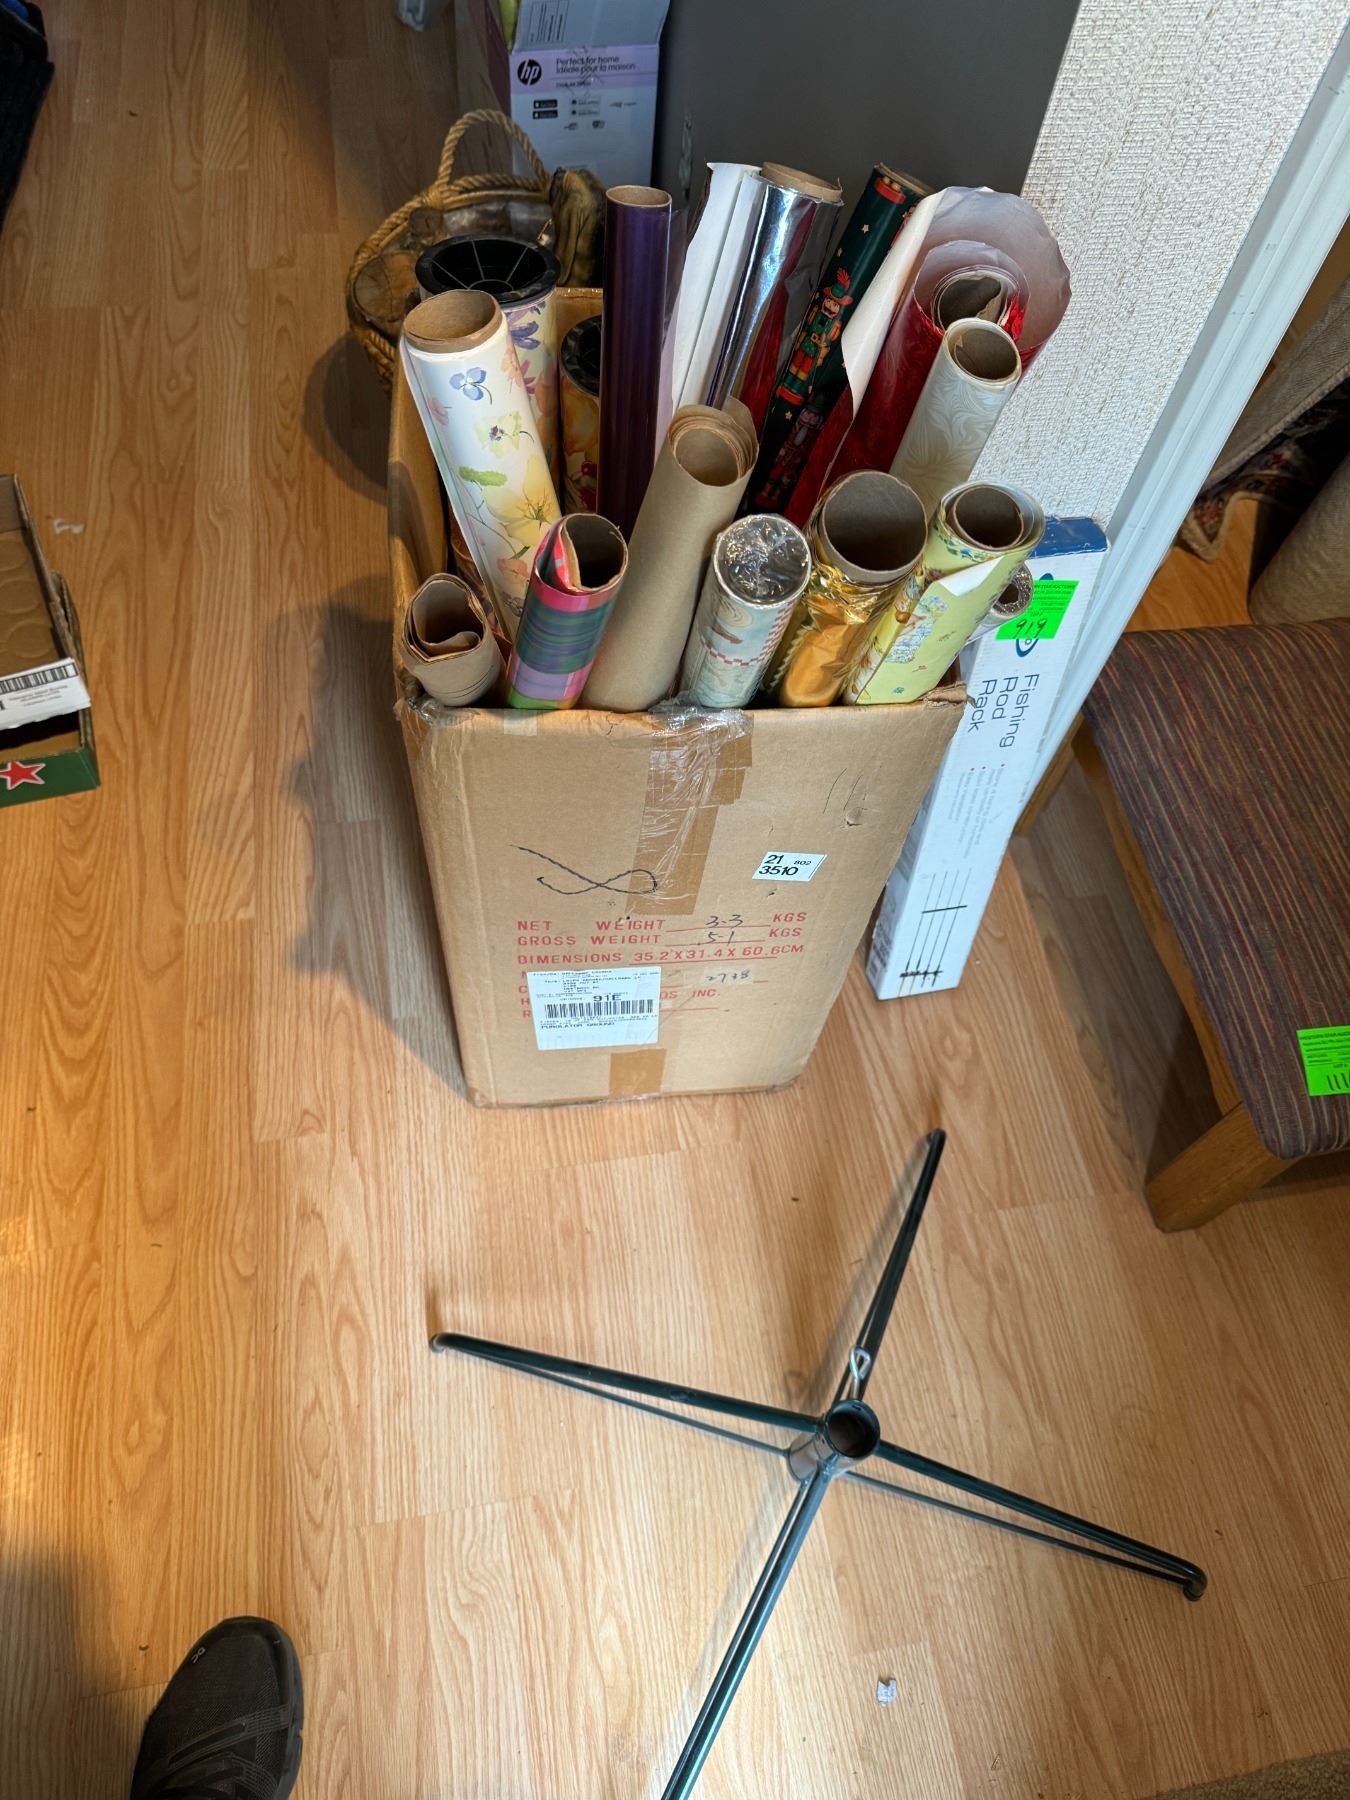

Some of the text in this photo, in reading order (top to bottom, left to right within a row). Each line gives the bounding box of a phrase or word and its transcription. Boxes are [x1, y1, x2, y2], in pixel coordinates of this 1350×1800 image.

[555, 57, 584, 66] Perfect
[586, 56, 598, 65] for
[608, 63, 636, 71] maison
[518, 58, 542, 87] hp
[1013, 618, 1047, 638] 919
[967, 679, 998, 734] Rack
[991, 676, 1019, 720] Rod
[999, 673, 1040, 748] Fishing
[763, 854, 785, 865] 21
[758, 865, 799, 876] 3510
[517, 911, 808, 931] NET WEIGHT KGS
[517, 927, 803, 947] GROSS WEIGHT KGS
[517, 952, 623, 965] DIMENSIONS
[592, 994, 622, 1002] 91E
